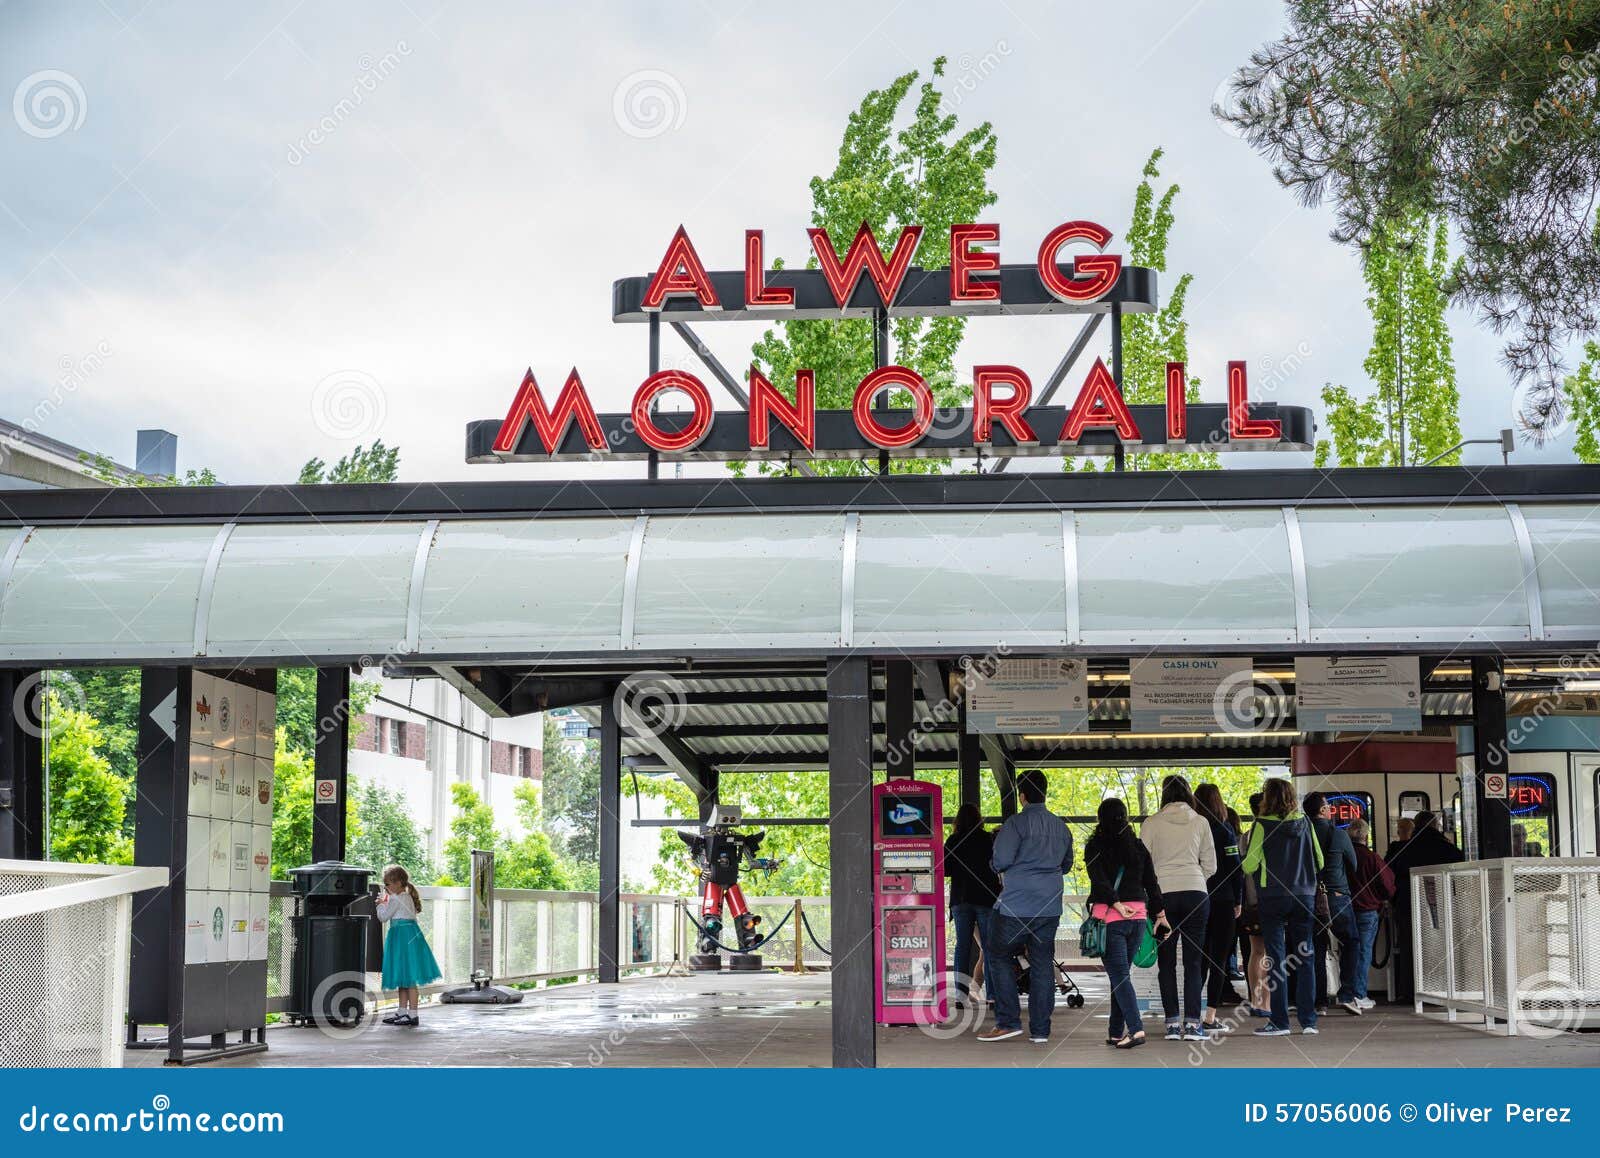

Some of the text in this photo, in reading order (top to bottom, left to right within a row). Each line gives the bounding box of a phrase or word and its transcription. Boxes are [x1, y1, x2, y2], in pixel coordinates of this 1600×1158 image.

[641, 220, 1123, 313] ALWEG
[492, 357, 1282, 457] MONORAIL
[1162, 661, 1218, 669] CASH ONLY
[1327, 805, 1360, 820] PEN
[890, 925, 927, 935] DATA
[891, 936, 928, 949] STASH
